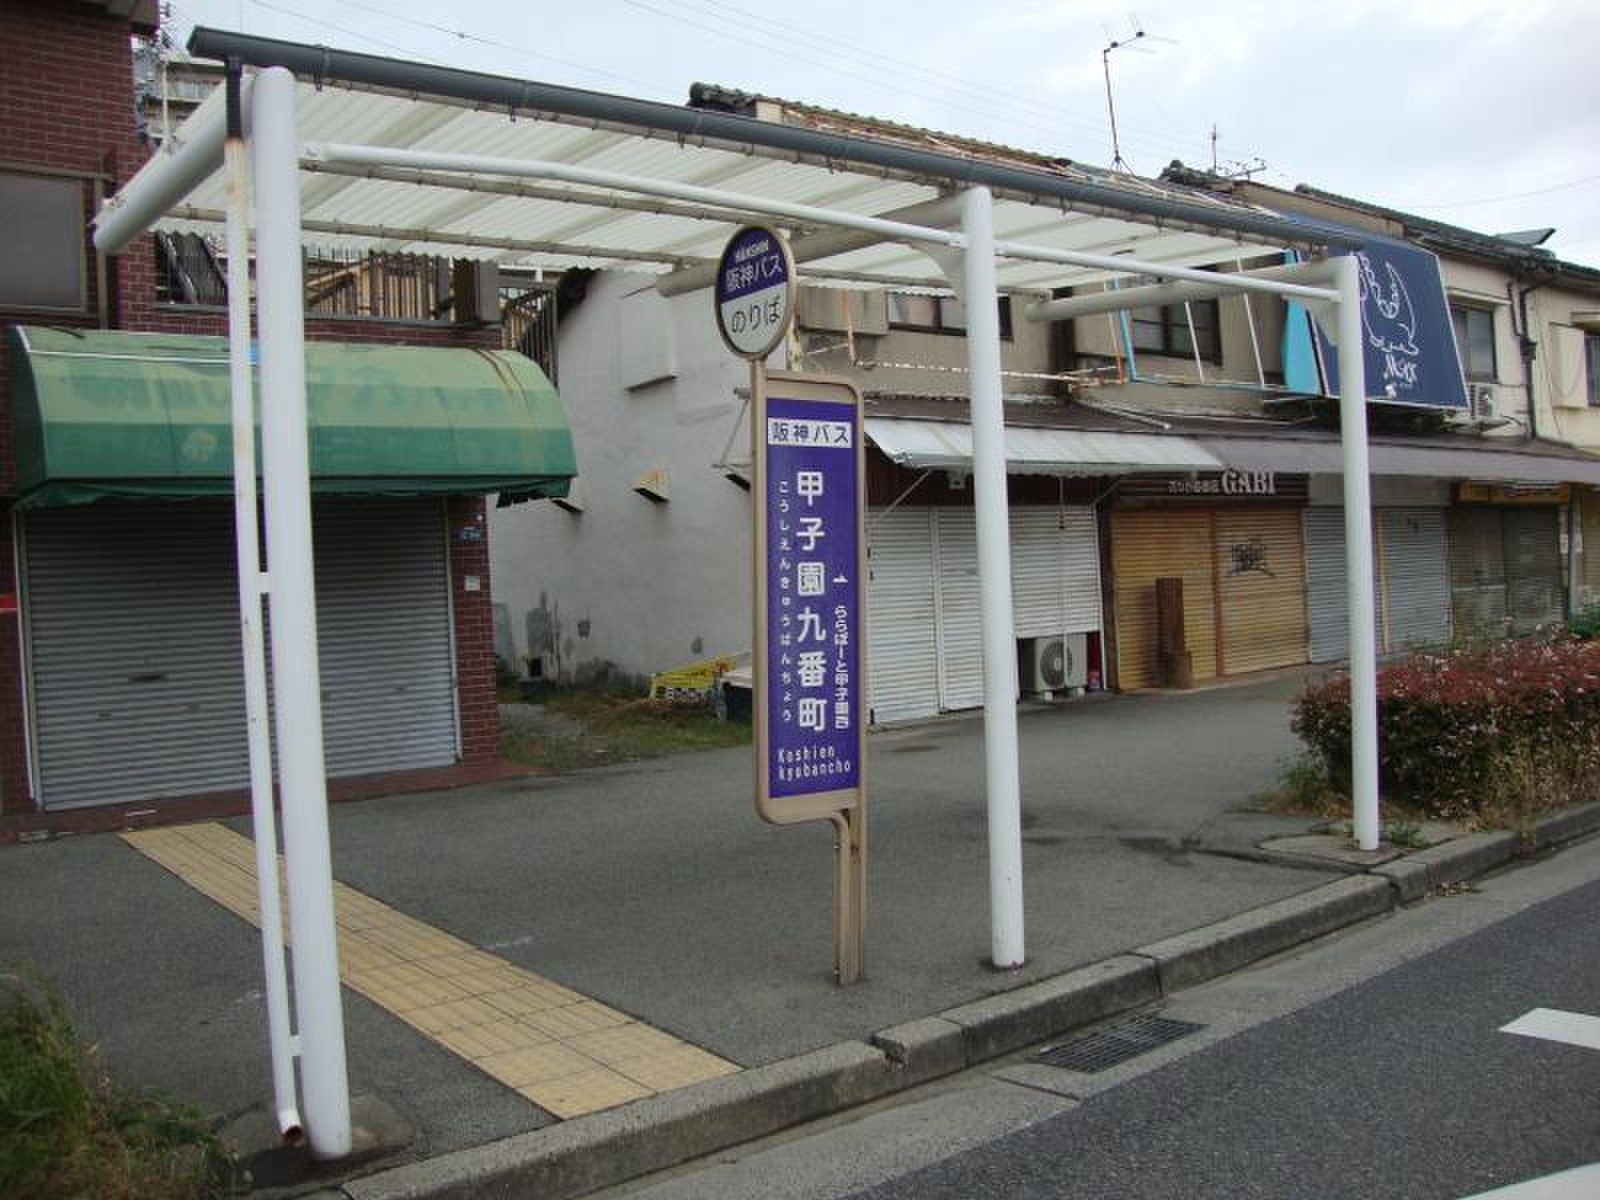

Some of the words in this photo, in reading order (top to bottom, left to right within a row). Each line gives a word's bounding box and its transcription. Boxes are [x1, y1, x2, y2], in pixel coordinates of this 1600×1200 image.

[725, 255, 783, 292] 阪神バス
[731, 294, 781, 334] のりば
[771, 421, 849, 444] 阪神バス
[1221, 470, 1276, 495] GABI
[796, 471, 827, 732] 甲子園九番町
[778, 744, 835, 765] Koshien
